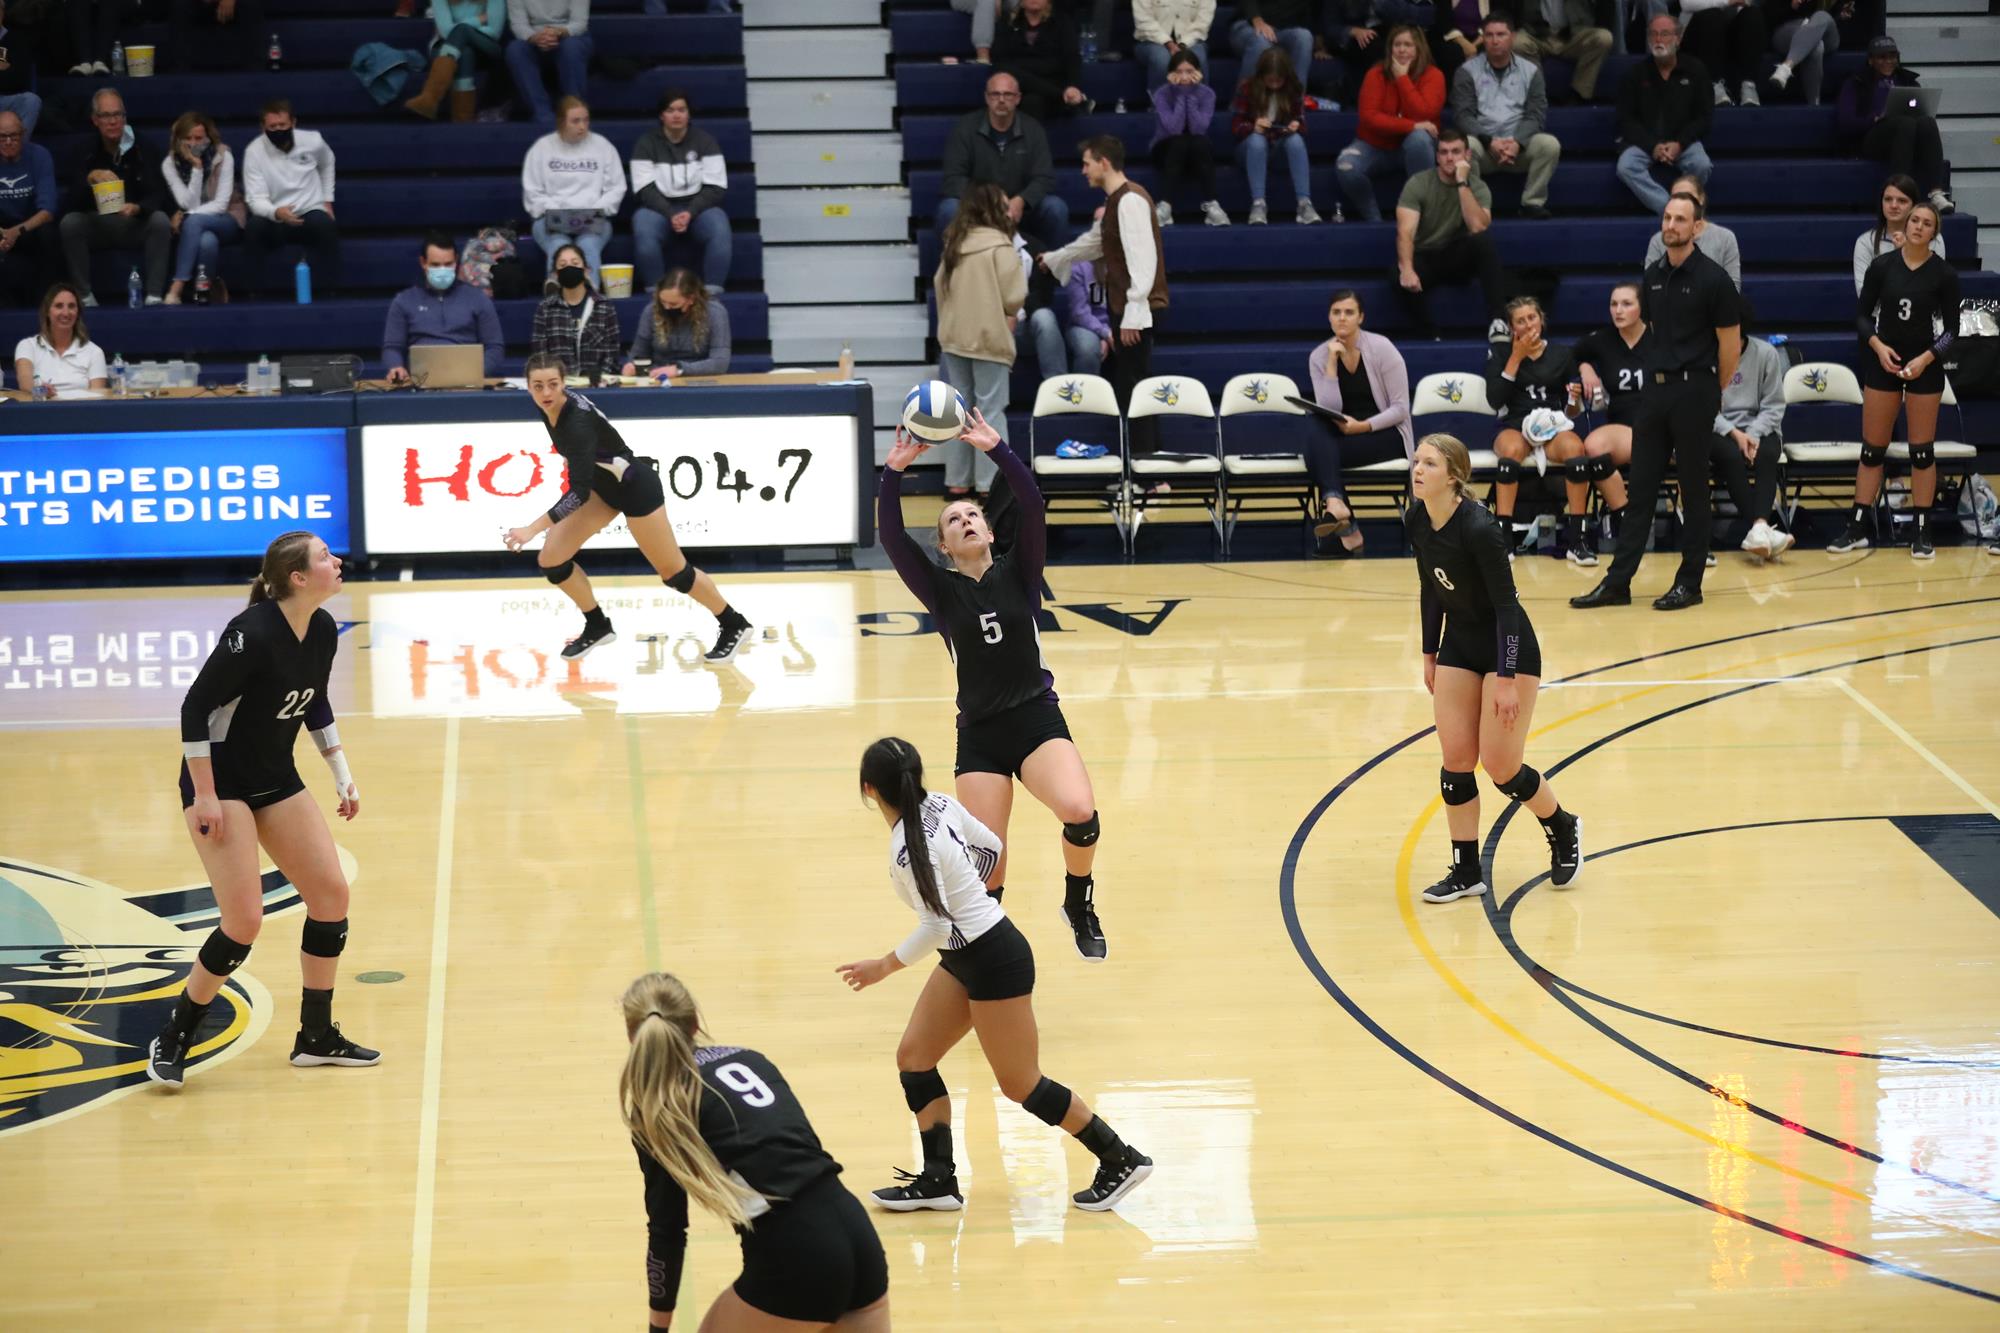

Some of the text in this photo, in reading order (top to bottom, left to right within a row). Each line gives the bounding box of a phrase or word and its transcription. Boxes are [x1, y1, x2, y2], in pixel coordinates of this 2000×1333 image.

[549, 160, 598, 170] COUGARS
[1898, 298, 1912, 321] 3
[1525, 384, 1547, 401] 11
[1619, 368, 1644, 391] 21
[634, 448, 813, 503] 04.7
[92, 494, 332, 524] MEDICINE
[1433, 567, 1455, 591] 8
[979, 611, 1003, 644] 5
[276, 687, 315, 720] 22
[715, 1062, 776, 1108] 9
